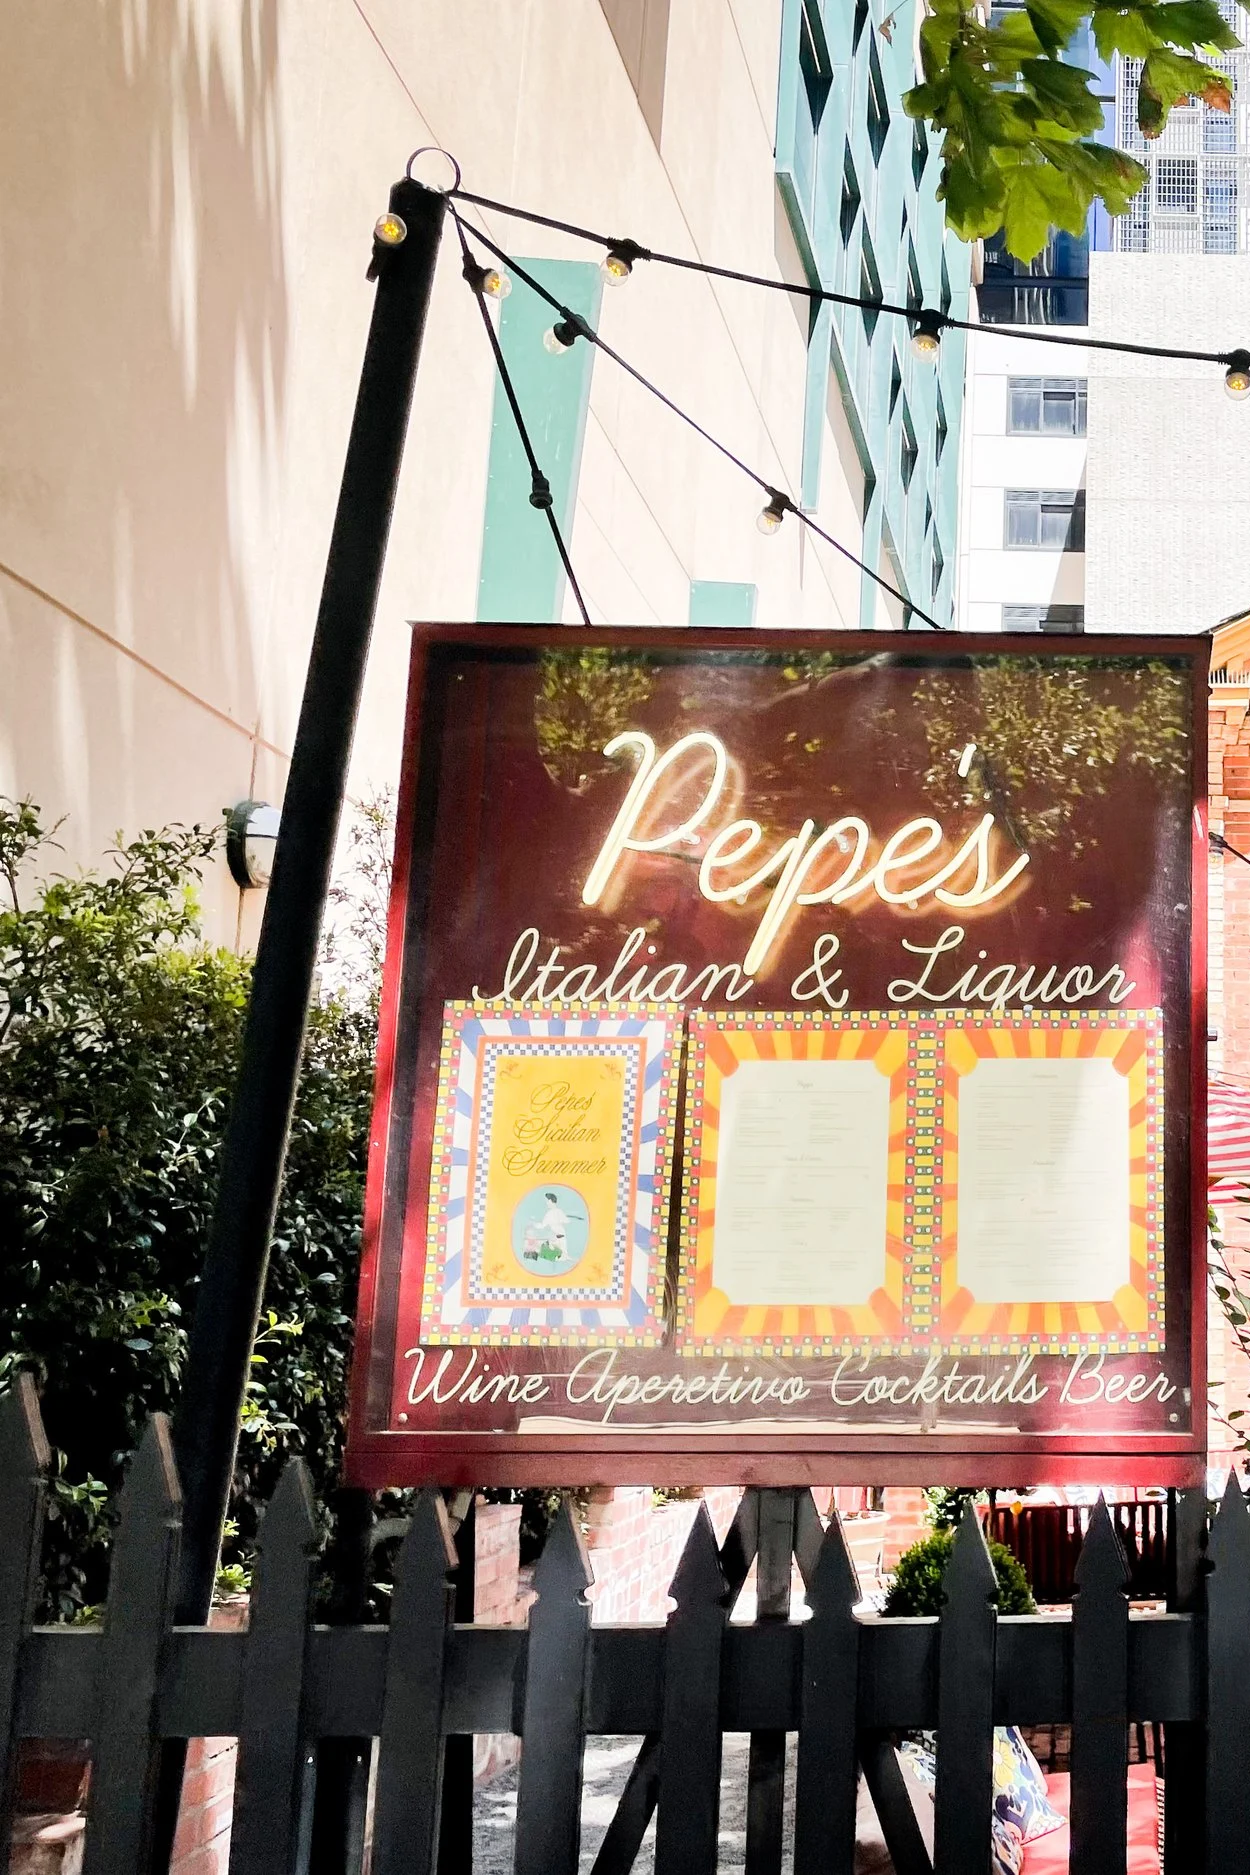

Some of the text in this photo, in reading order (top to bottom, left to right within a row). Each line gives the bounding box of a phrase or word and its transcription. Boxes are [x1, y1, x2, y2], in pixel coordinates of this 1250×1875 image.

[472, 926, 1136, 1010] Italian & Liquor
[513, 1113, 600, 1145] Sicilian
[502, 1146, 607, 1177] Summer
[404, 1347, 1177, 1424] Wine Aperetivo Cocktails Beer
